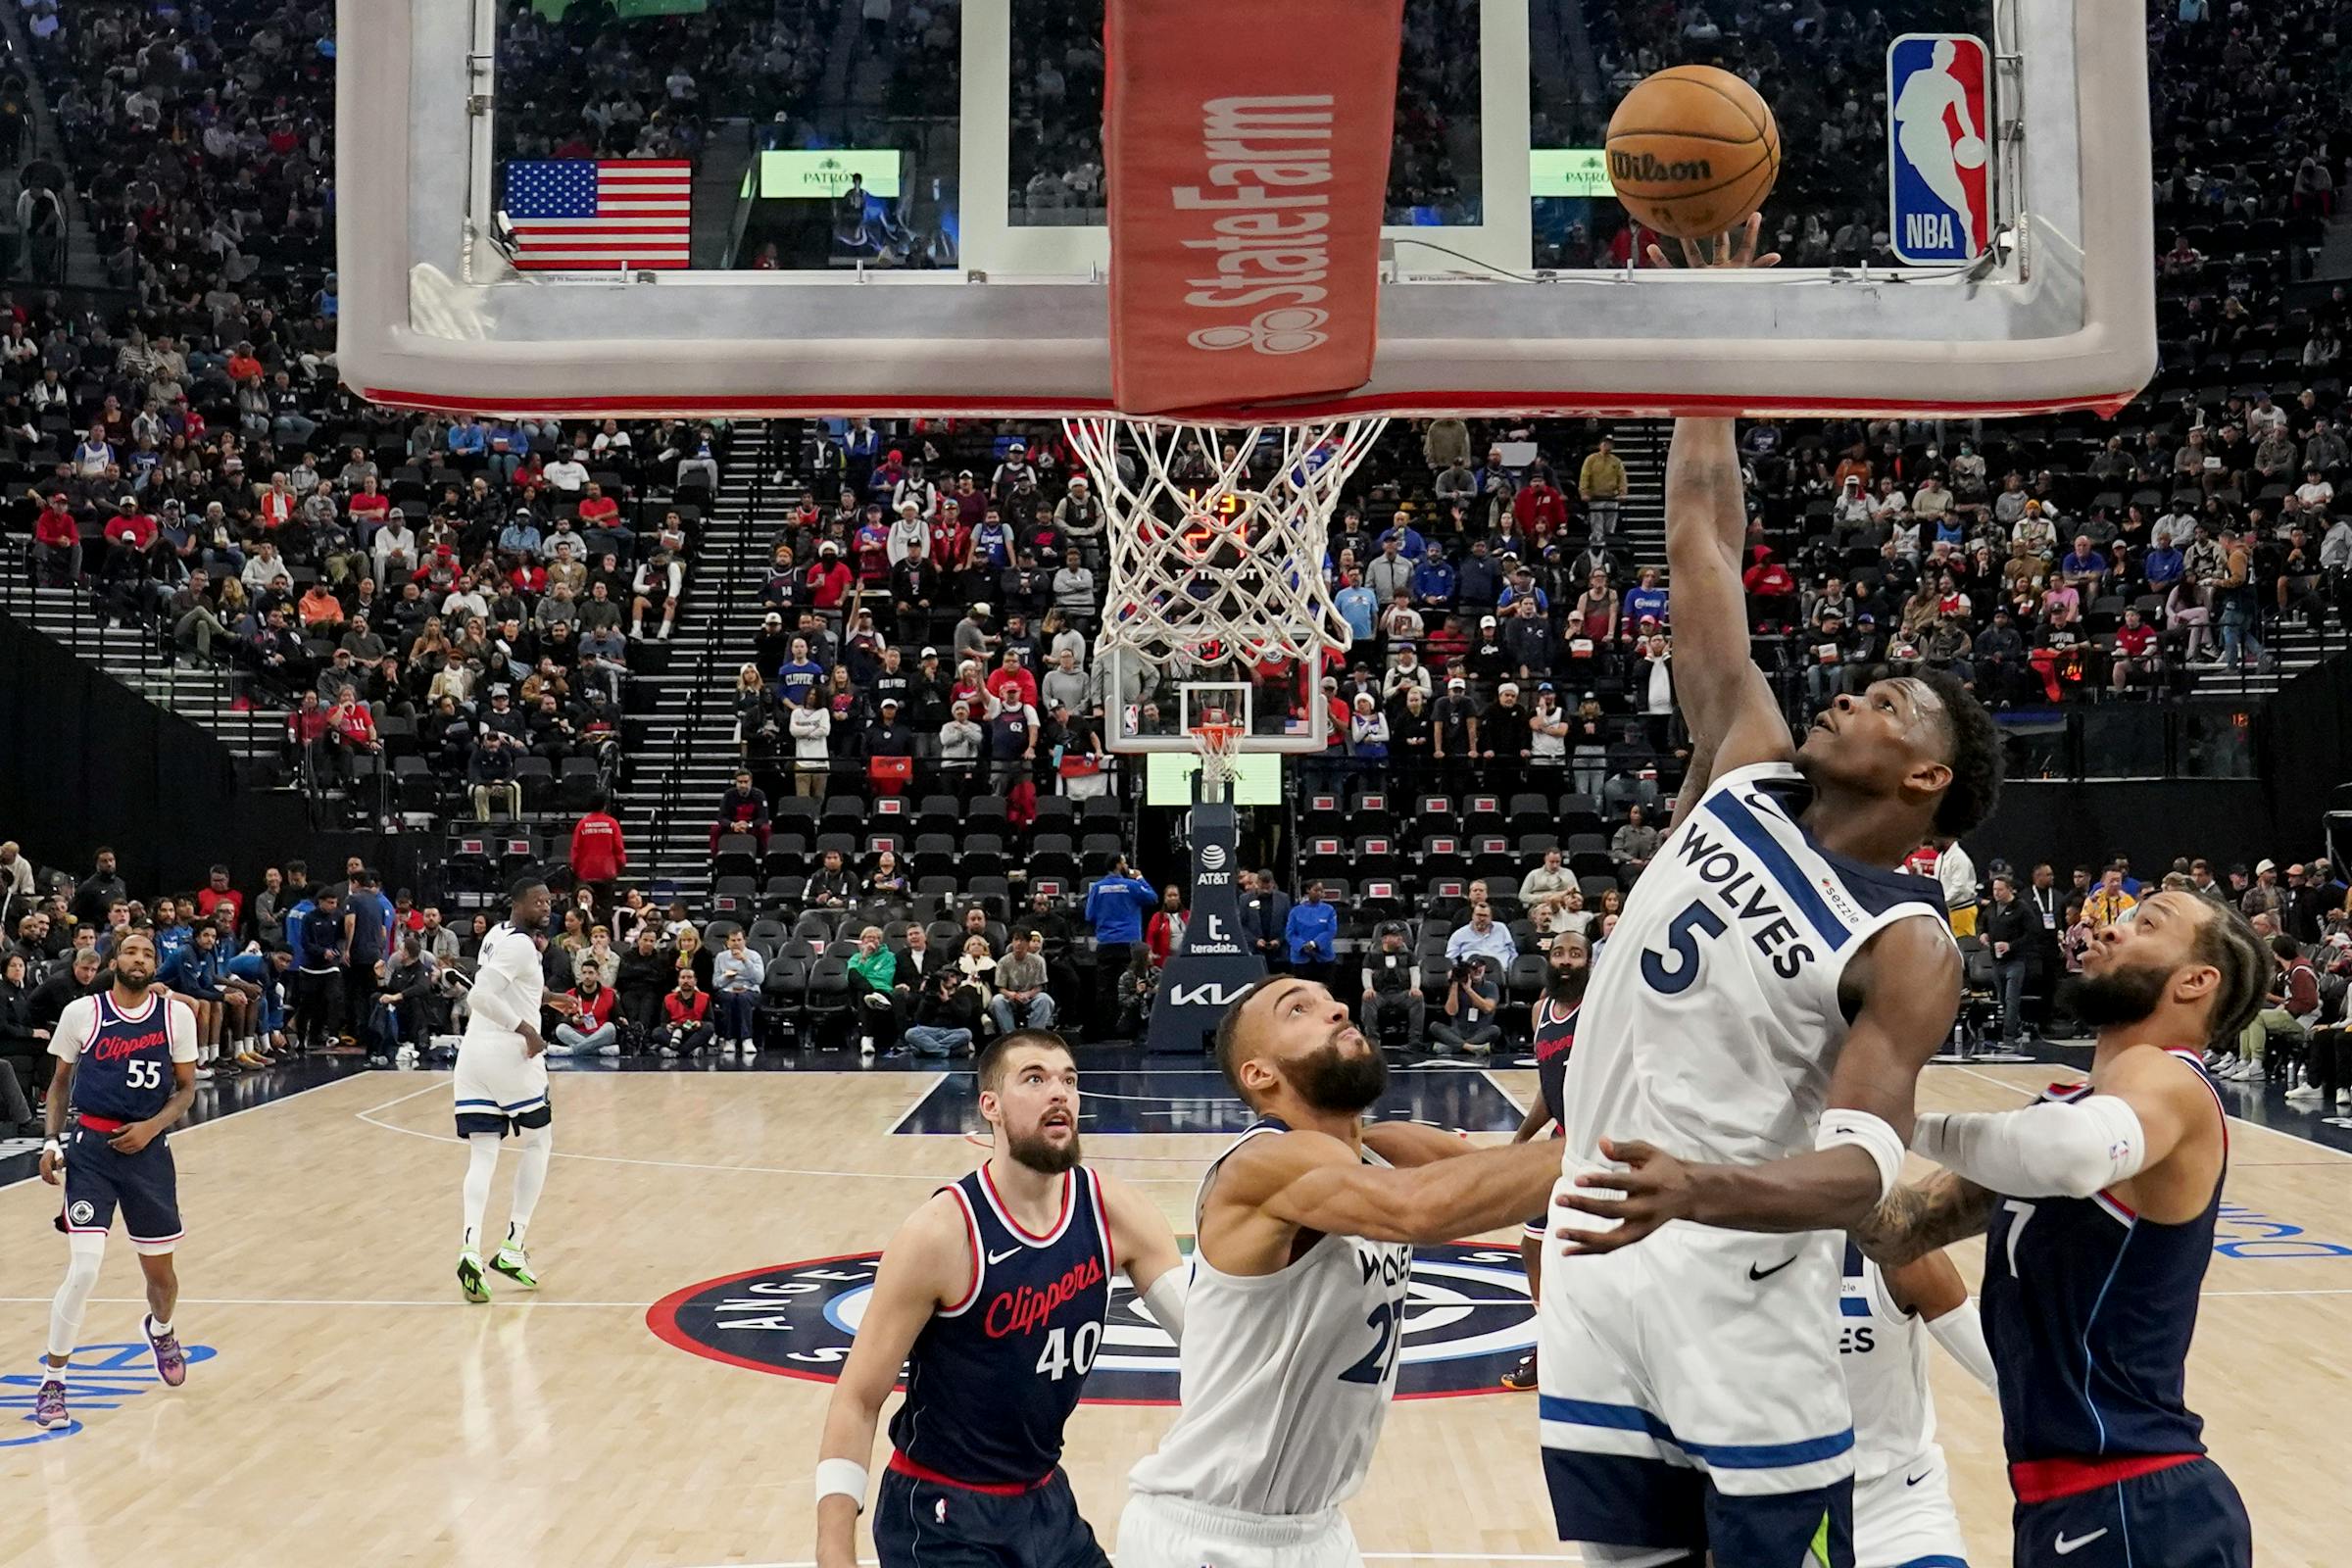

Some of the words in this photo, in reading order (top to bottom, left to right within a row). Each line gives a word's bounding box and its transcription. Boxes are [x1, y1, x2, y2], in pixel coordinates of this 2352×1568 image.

[1611, 149, 1713, 182] Wilson
[1905, 213, 1955, 250] NBA
[1009, 720, 1024, 733] 62
[1197, 871, 1232, 887] AT&T
[1677, 822, 1815, 979] WOLVES
[1826, 885, 1860, 925] sezzle
[1191, 943, 1242, 955] teradata.
[1640, 898, 1729, 995] 5
[95, 1030, 167, 1062] Clippers
[125, 1058, 162, 1090] 55
[985, 1254, 1103, 1339] Clippers
[1035, 1320, 1102, 1382] 40
